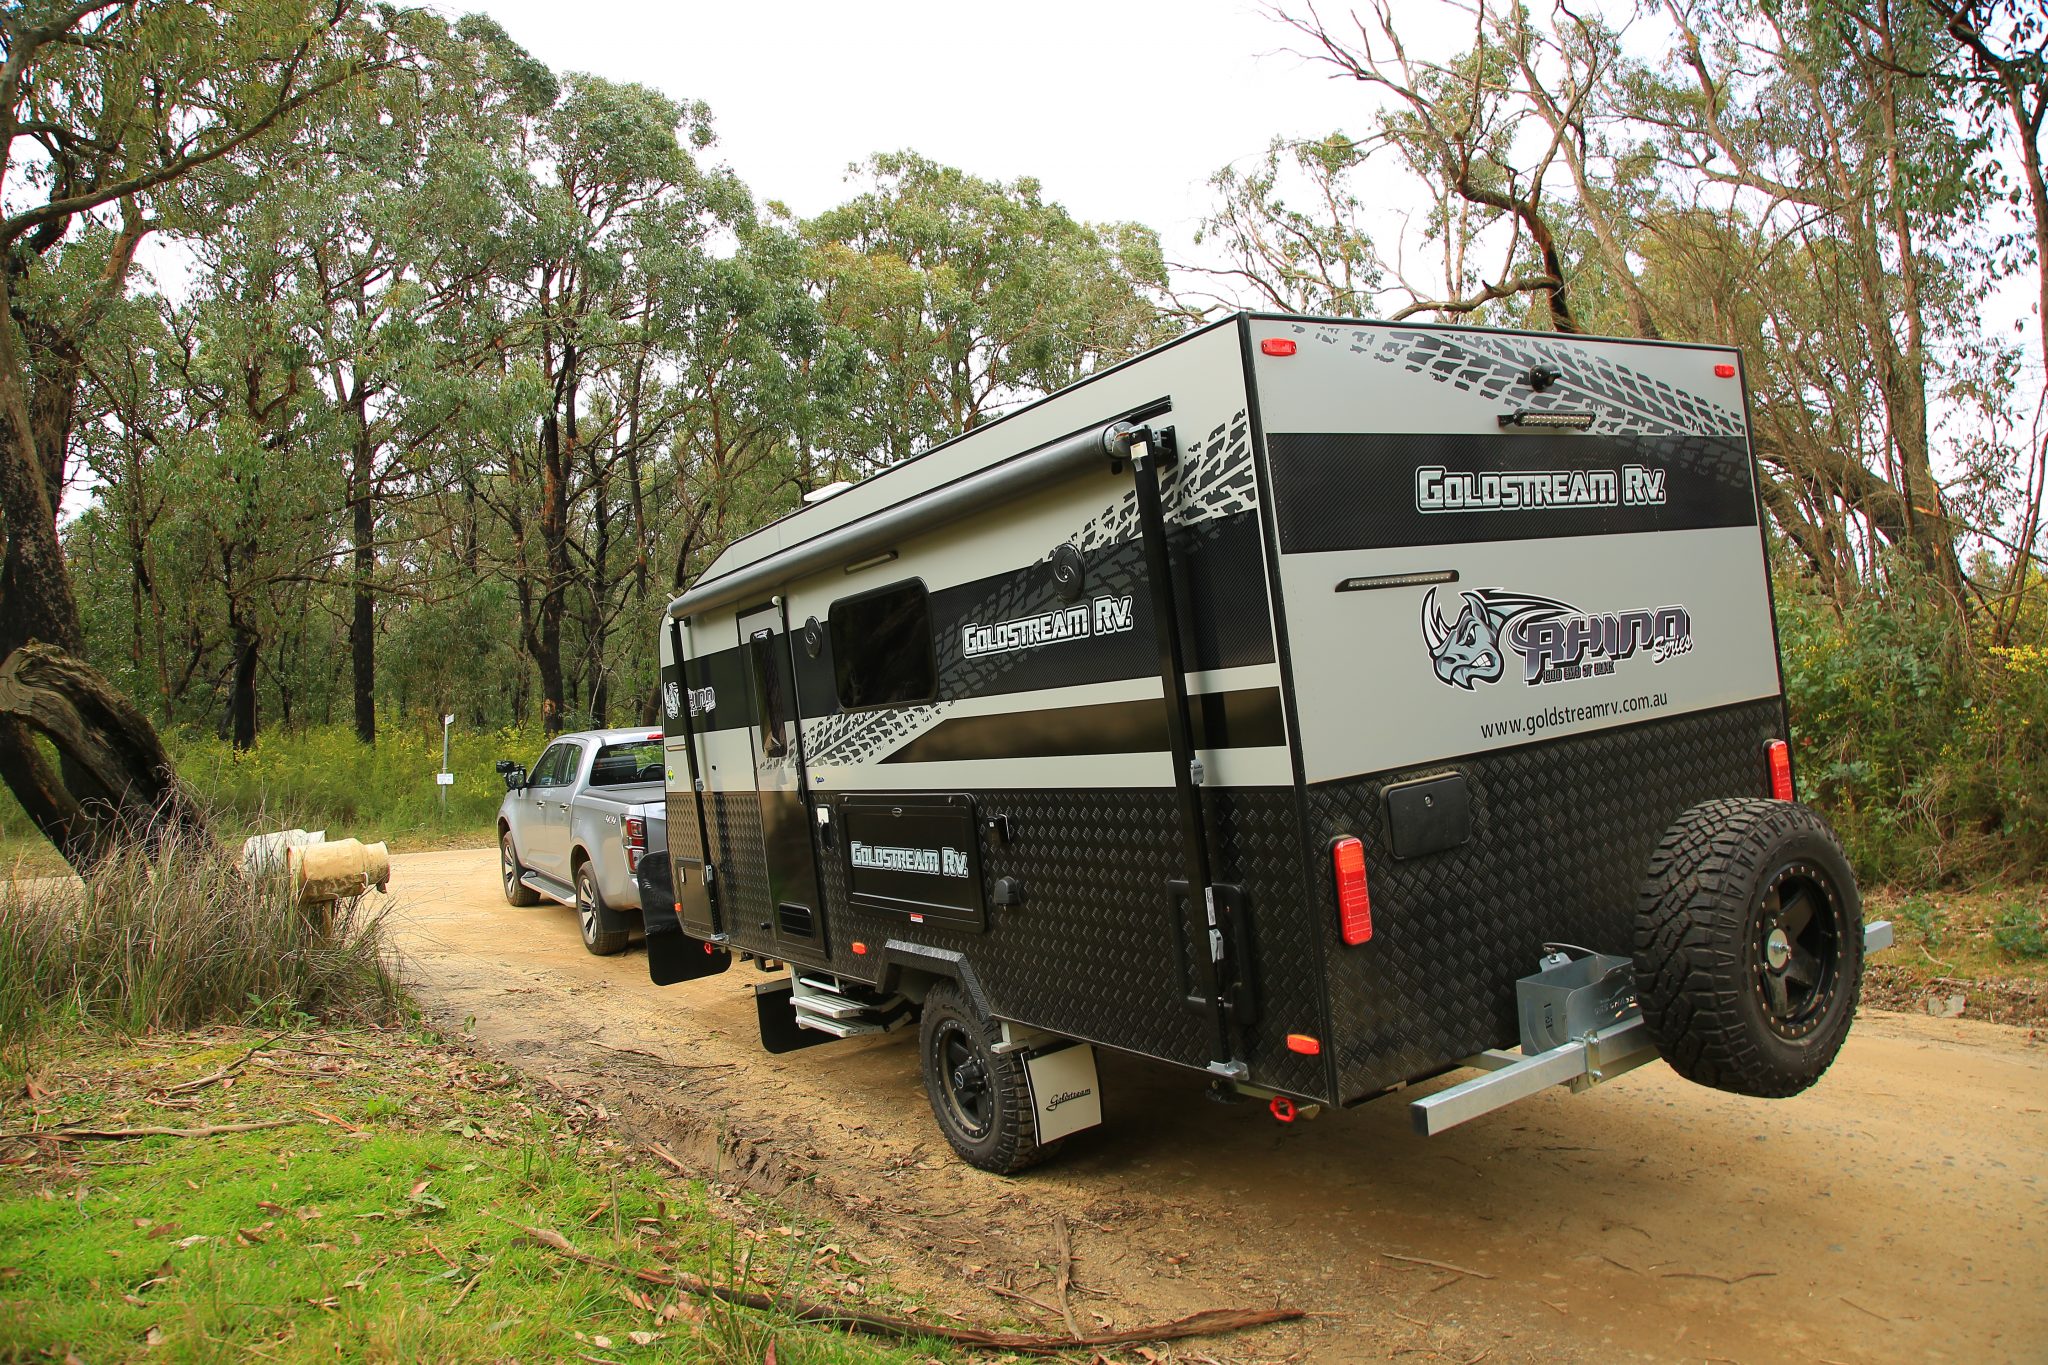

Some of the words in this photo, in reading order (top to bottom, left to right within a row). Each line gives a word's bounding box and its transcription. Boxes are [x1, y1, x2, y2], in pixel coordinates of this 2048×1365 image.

[1415, 465, 1618, 513] GOLDSTREAM
[963, 605, 1090, 658] GOLDSTREAM
[1651, 636, 1694, 665] Series
[1542, 668, 1562, 683] 1800
[1480, 691, 1668, 739] www.goldstreamrv.com.au
[851, 841, 940, 875] GOLDSTREAM
